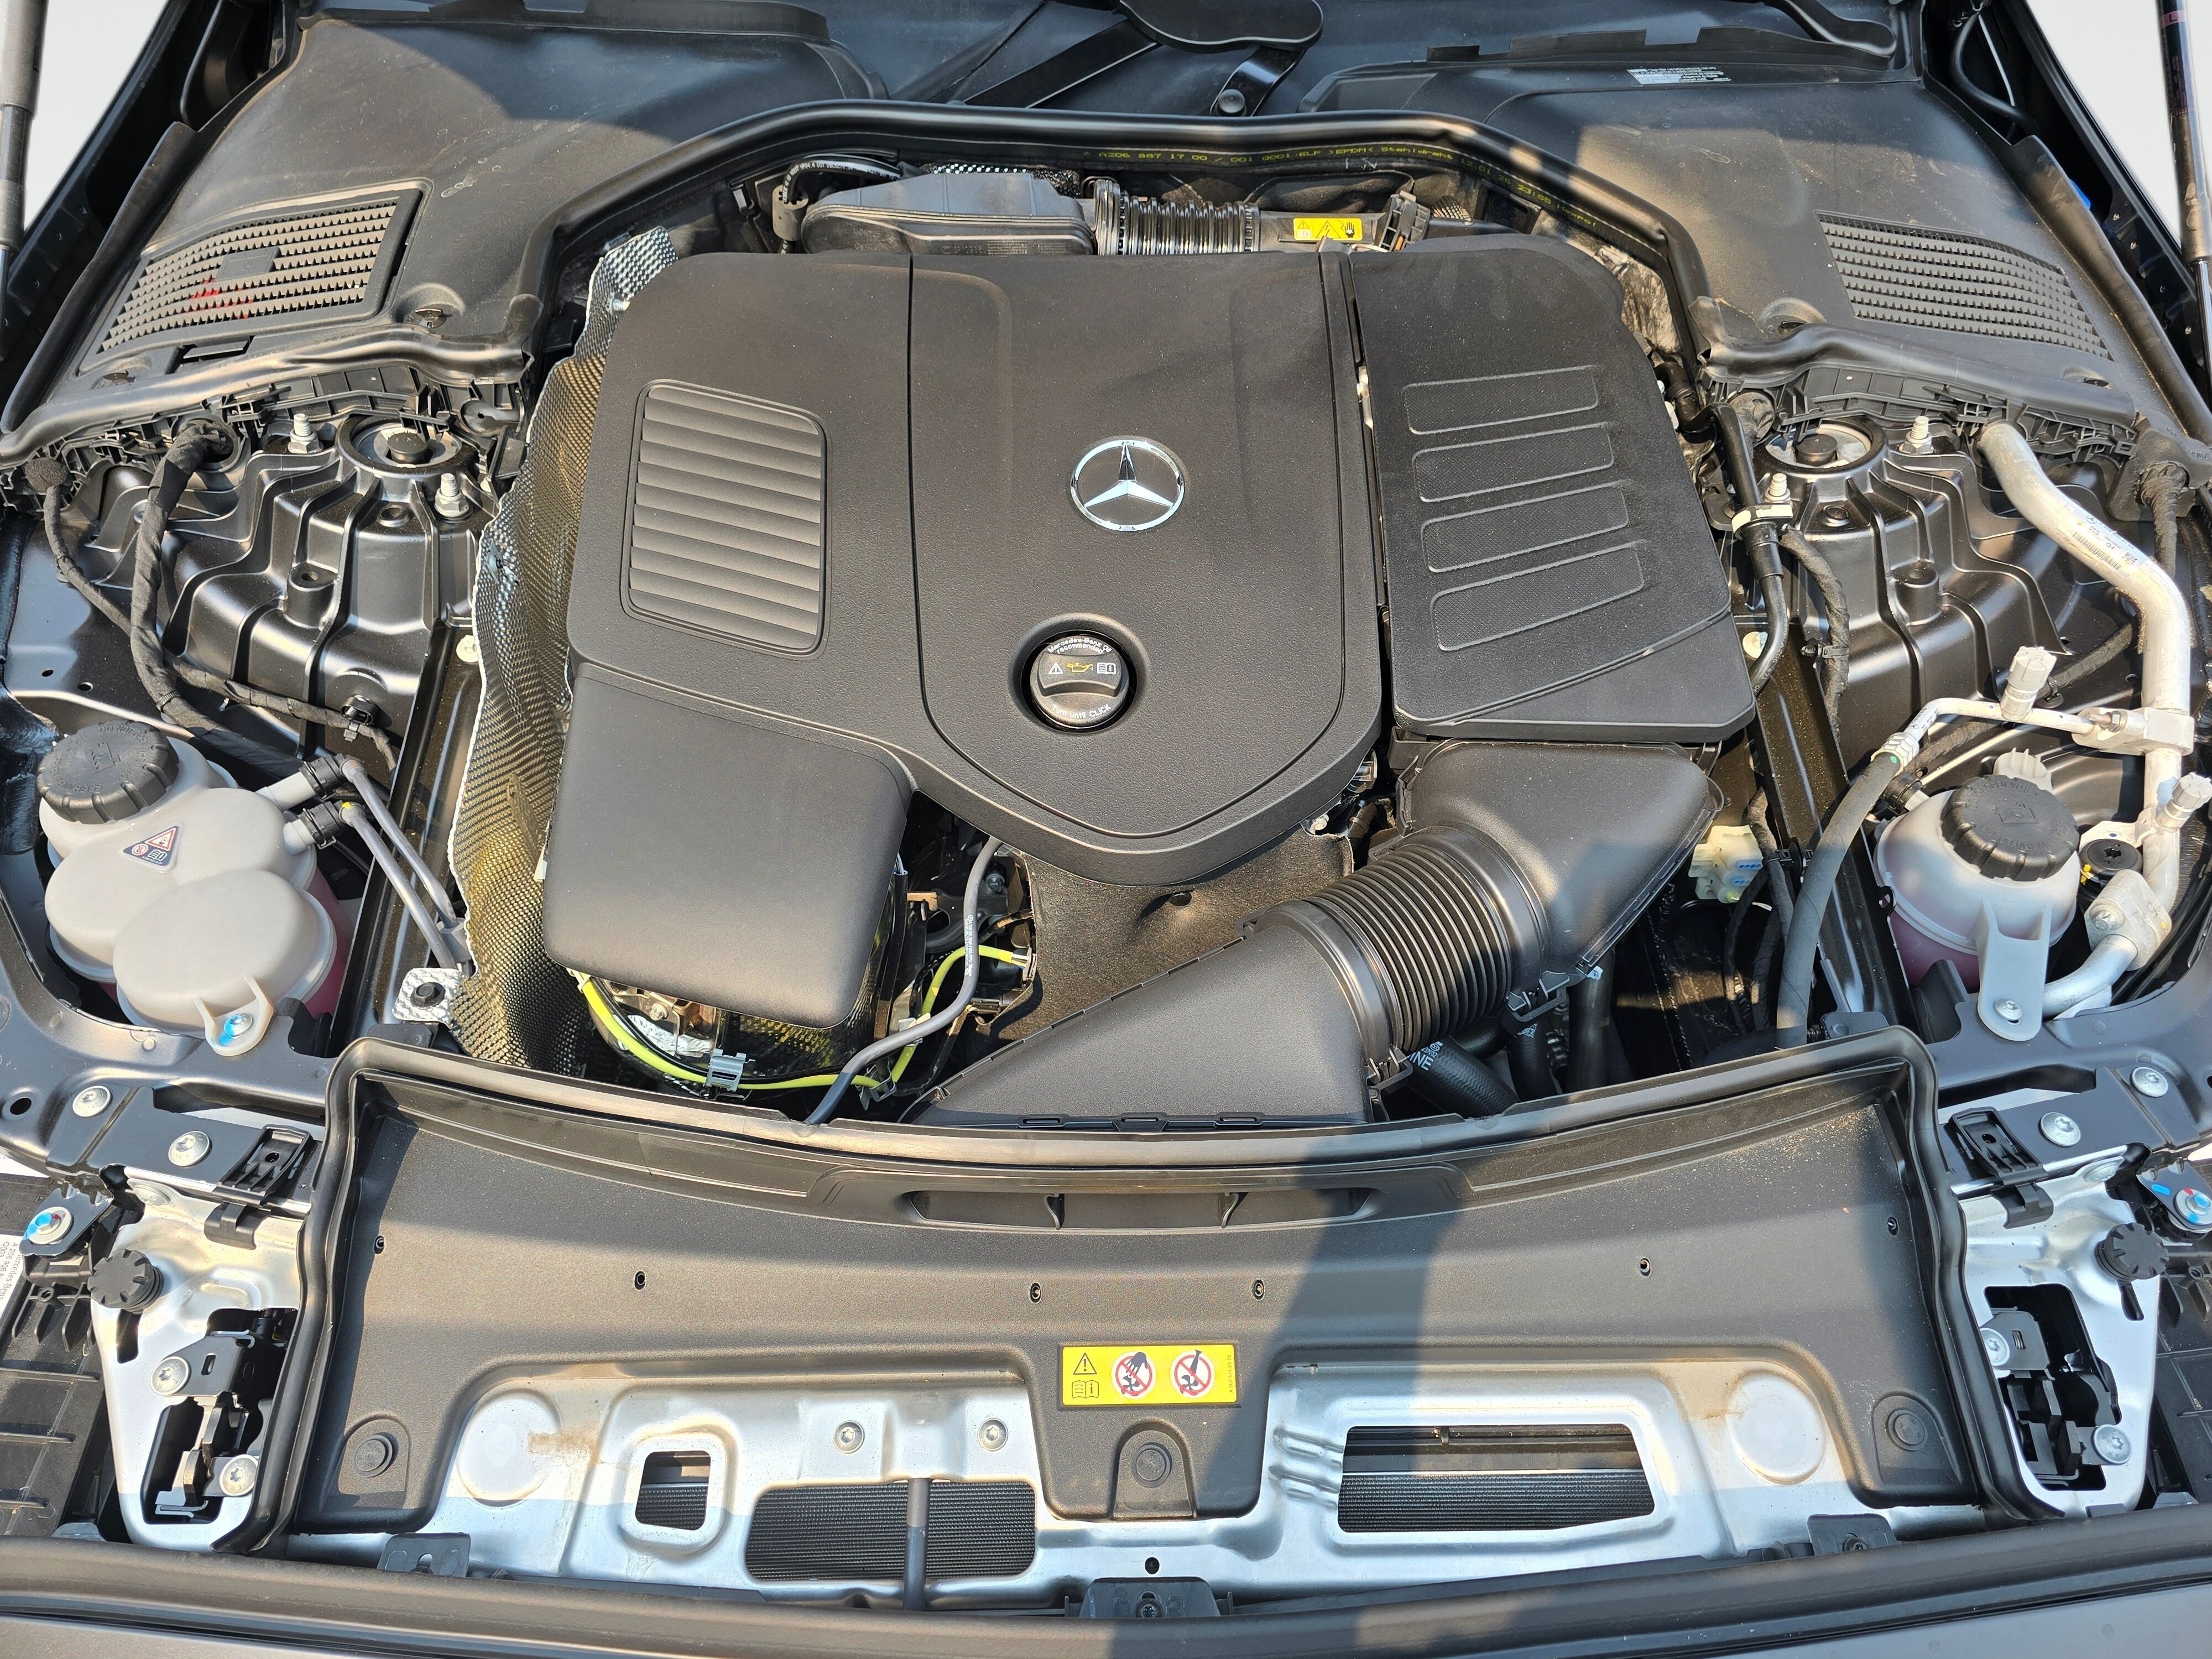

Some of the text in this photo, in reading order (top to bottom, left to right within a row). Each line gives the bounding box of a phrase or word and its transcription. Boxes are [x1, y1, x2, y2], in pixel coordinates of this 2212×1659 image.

[1328, 147, 1374, 155] >EPDM<
[1381, 146, 1454, 160] Stahldraht
[1047, 637, 1113, 653] Mercedes-Benz Oil
[1057, 644, 1104, 655] recommended
[1052, 703, 1067, 717] Turn
[1089, 704, 1112, 718] CLICK
